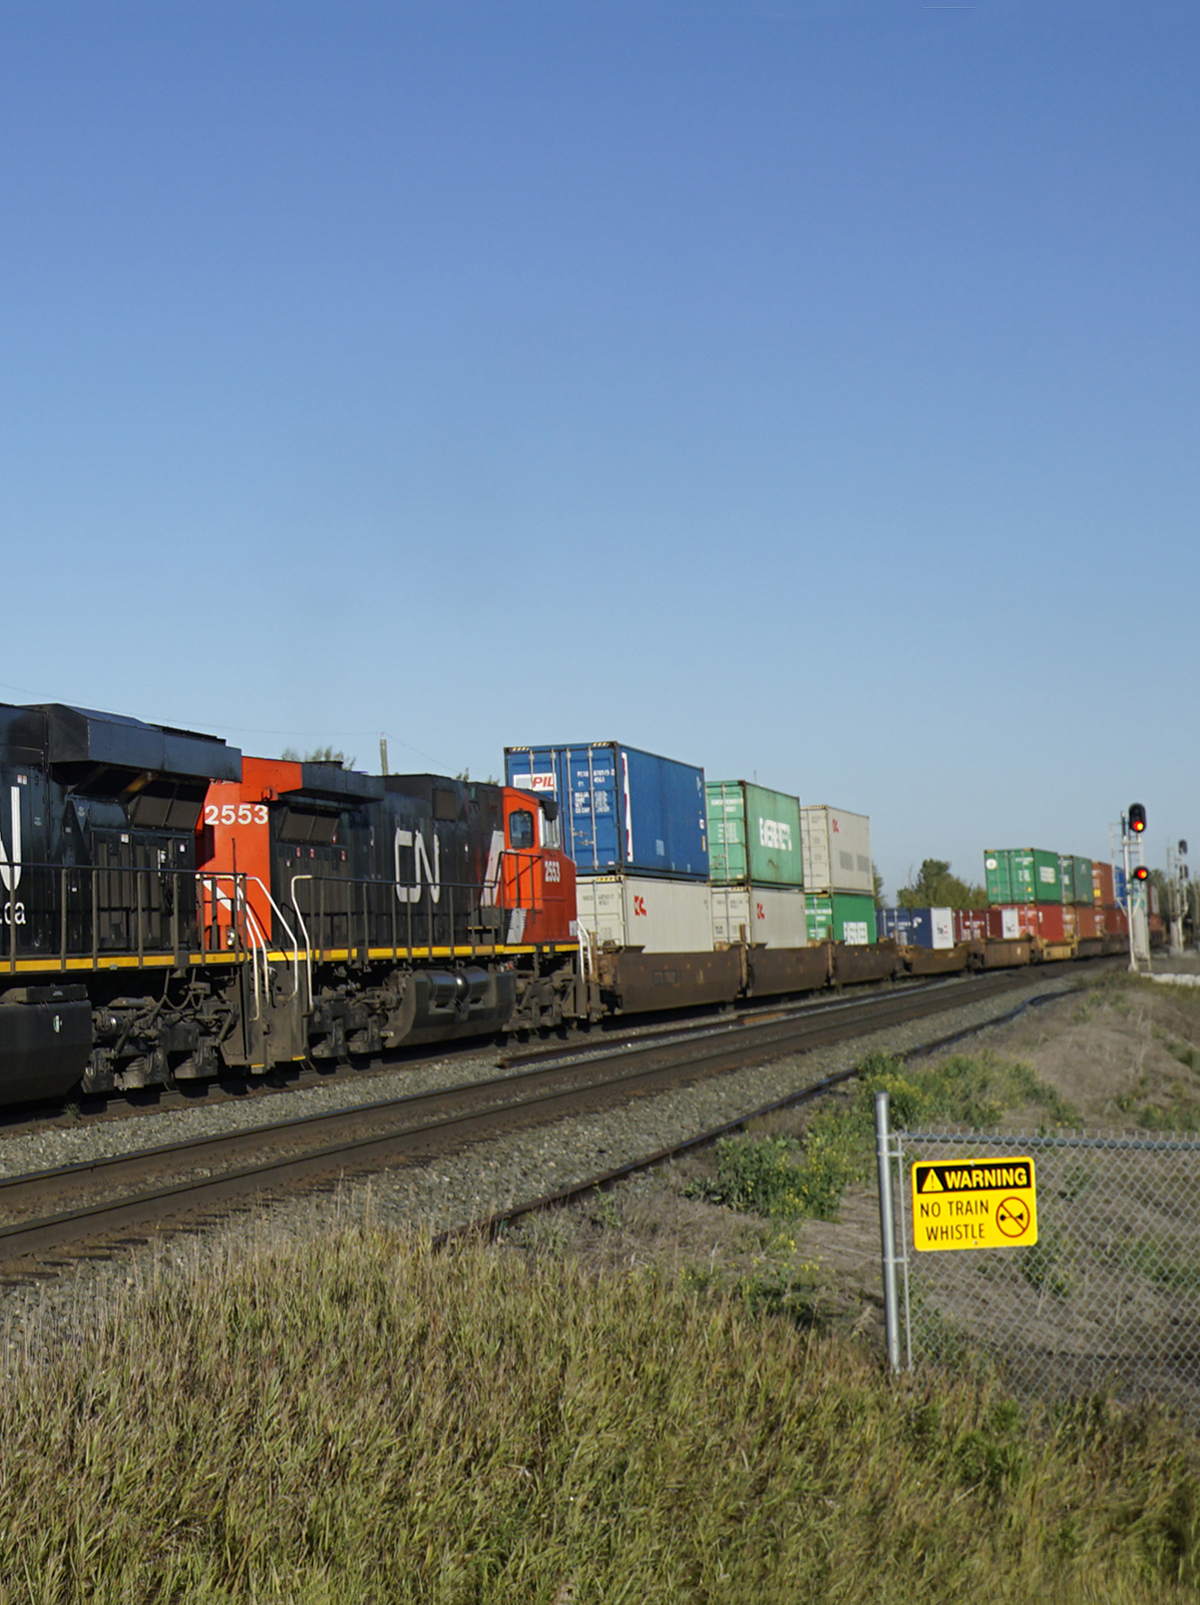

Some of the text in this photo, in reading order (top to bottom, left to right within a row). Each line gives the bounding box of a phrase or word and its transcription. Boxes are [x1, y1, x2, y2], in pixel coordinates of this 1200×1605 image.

[532, 776, 555, 787] PIL
[204, 804, 269, 825] 2553
[395, 828, 440, 904] CN
[544, 861, 561, 882] 2553
[944, 1167, 1028, 1189] WARNING
[920, 1200, 989, 1218] NO TRAIN
[926, 1223, 985, 1241] WHISTLE
